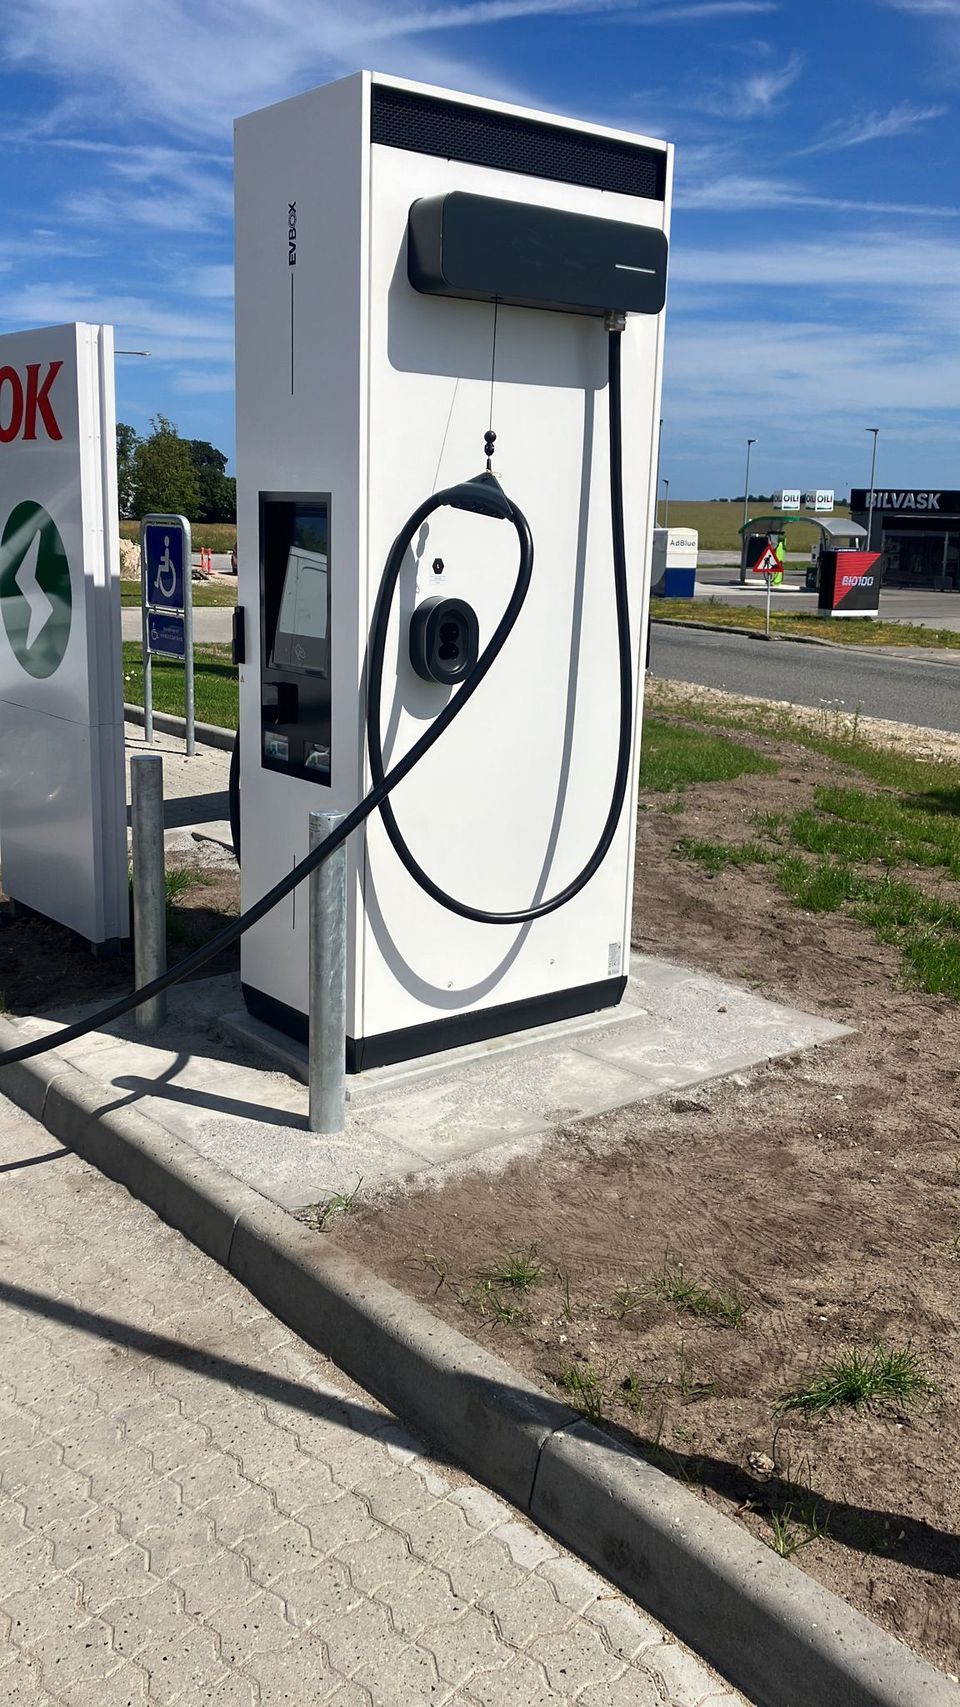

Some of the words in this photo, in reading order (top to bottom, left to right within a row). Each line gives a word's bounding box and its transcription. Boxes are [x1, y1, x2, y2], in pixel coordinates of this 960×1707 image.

[288, 201, 297, 266] EVBOX
[0, 361, 64, 443] OK
[865, 492, 941, 510] BILVASK
[670, 539, 696, 547] AdBlue
[841, 576, 874, 586] BIO100
